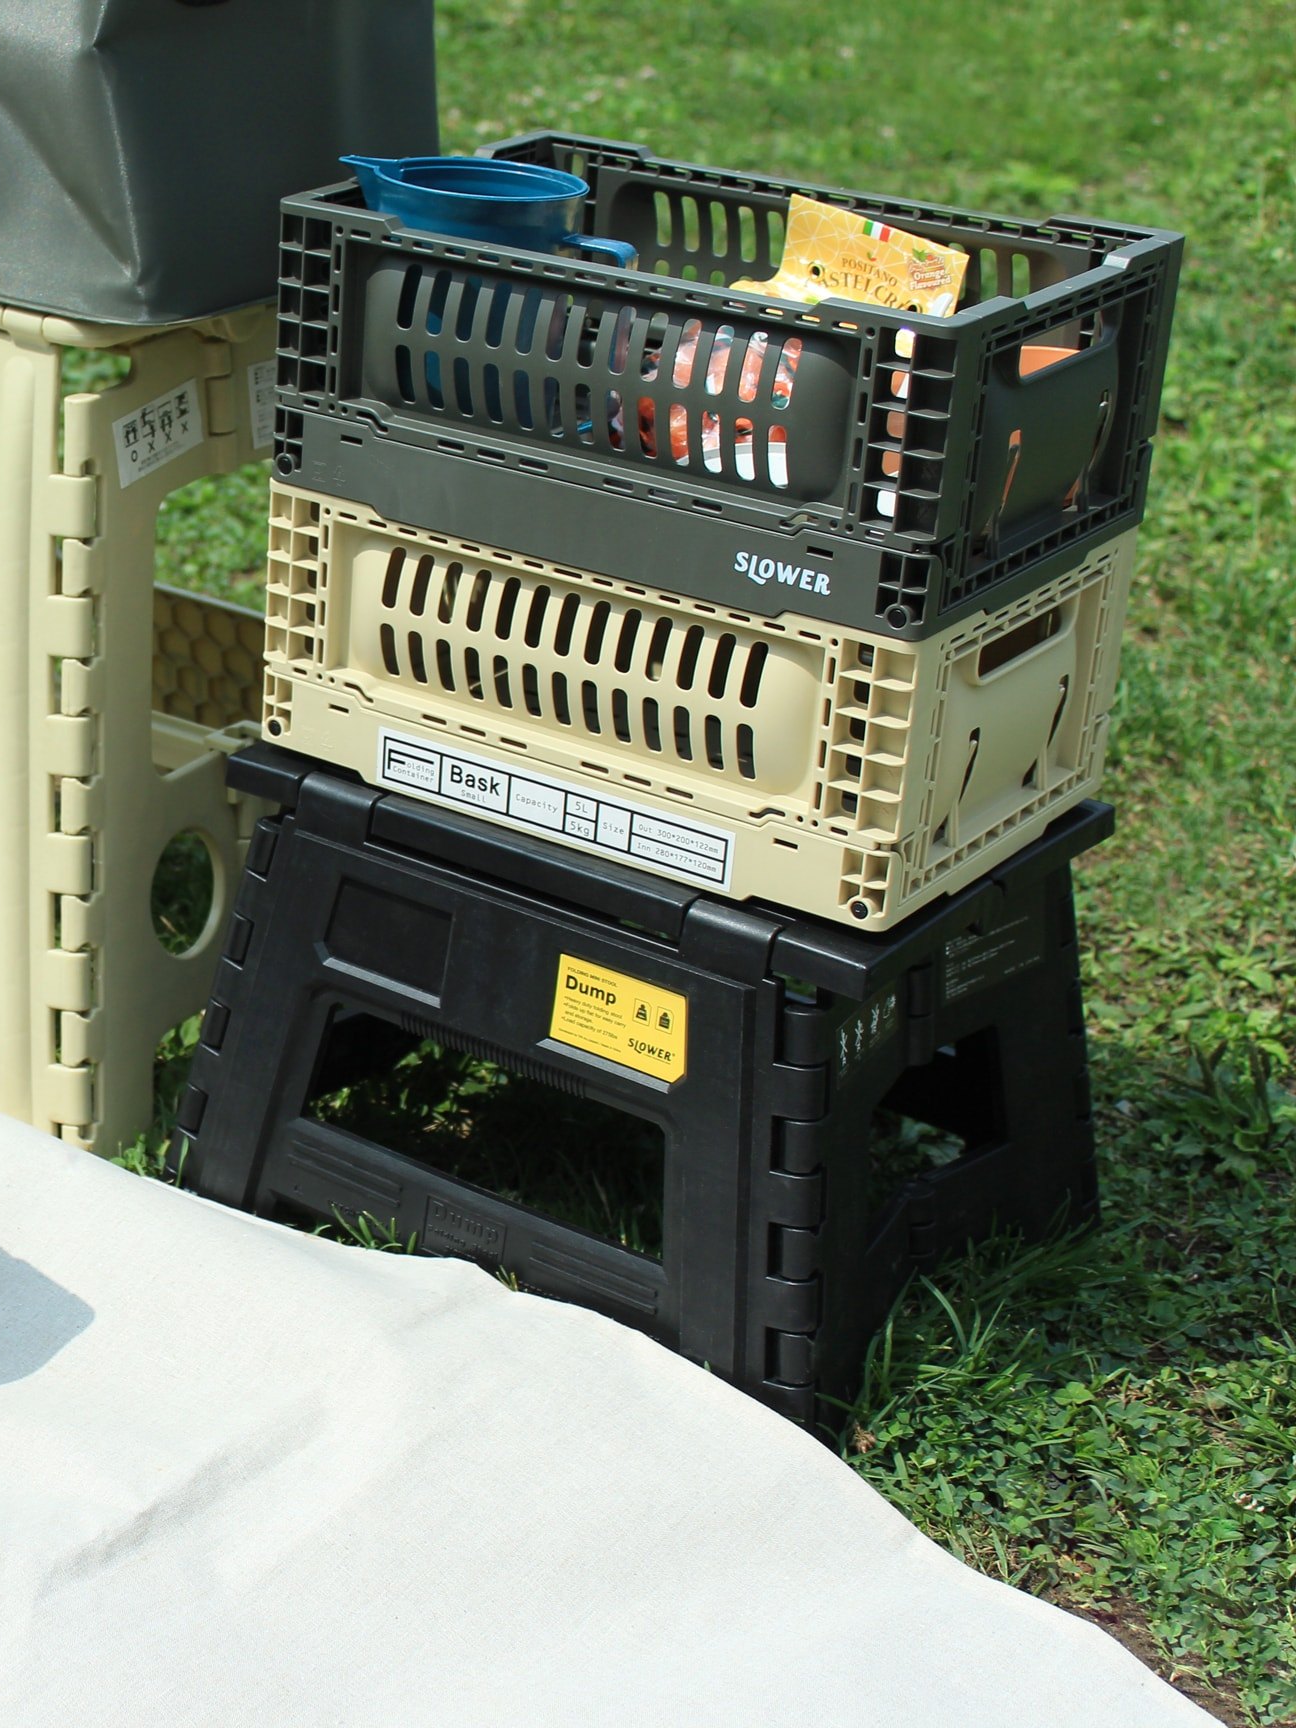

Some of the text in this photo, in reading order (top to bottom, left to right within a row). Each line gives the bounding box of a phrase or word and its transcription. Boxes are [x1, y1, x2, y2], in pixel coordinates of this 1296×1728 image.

[842, 257, 898, 287] POSITANO
[734, 551, 831, 596] SLOWER
[392, 765, 434, 783] Container
[450, 764, 501, 796] Bask
[461, 789, 487, 803] Small
[515, 793, 559, 814] Capacity
[575, 801, 588, 814] 5L
[570, 821, 590, 837] 5kg
[602, 822, 625, 835] Size
[638, 823, 653, 834] Out
[637, 842, 652, 852] Inn
[565, 974, 616, 1005] Dump
[627, 1037, 672, 1062] SLOWER
